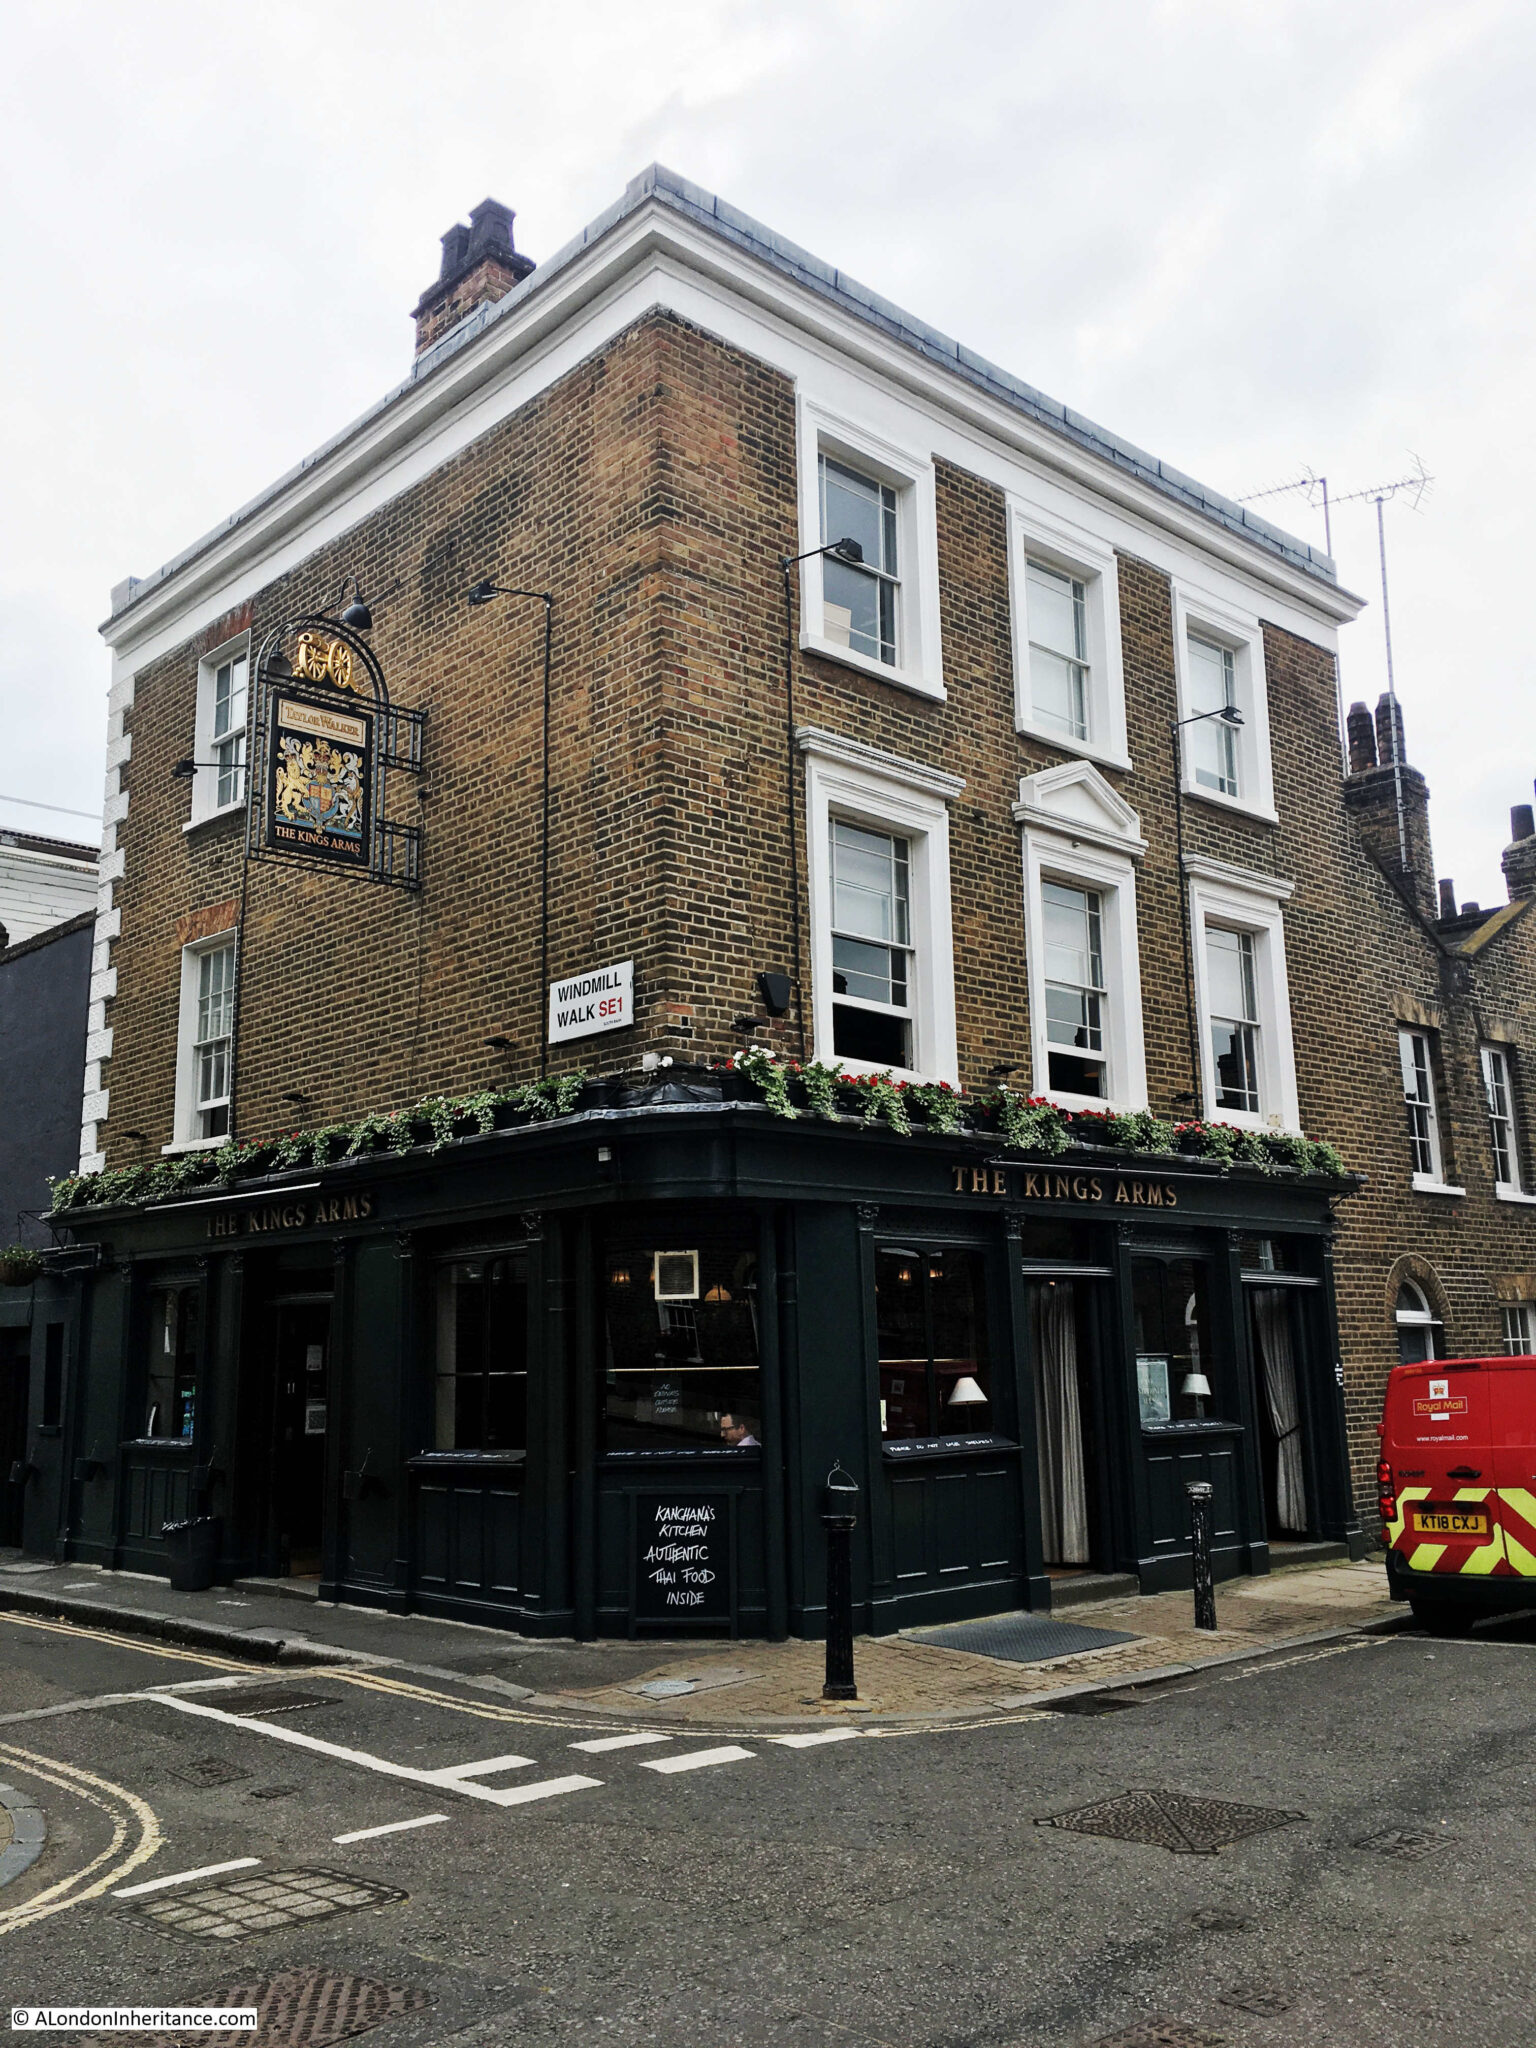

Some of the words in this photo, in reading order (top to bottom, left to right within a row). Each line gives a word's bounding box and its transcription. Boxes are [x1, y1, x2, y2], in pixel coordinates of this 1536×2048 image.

[319, 715, 359, 736] WALKER
[275, 826, 296, 839] THE
[298, 830, 329, 847] KINGS
[331, 838, 361, 853] ARMS
[558, 972, 621, 1002] WINDMILL
[557, 1004, 595, 1027] WALK
[599, 997, 623, 1017] SE1
[952, 1166, 1007, 1194] THE
[1024, 1172, 1103, 1200] KINGS
[1115, 1181, 1177, 1207] ARMS
[206, 1214, 237, 1237] THE
[249, 1205, 306, 1232] KINGS
[315, 1193, 372, 1224] ARMS
[1416, 1401, 1441, 1413] Royal
[1443, 1400, 1463, 1410] Mail
[1416, 1434, 1468, 1443] www.royalmail.com
[655, 1505, 716, 1522] KANCHANA'S
[1421, 1515, 1449, 1529] KT18
[1452, 1516, 1479, 1530] CXJ
[659, 1523, 708, 1538] KITCHEN
[643, 1543, 710, 1563] AUTHENTIC
[649, 1567, 676, 1585] THAI
[681, 1566, 716, 1584] FOOD
[666, 1590, 705, 1606] INSIDE
